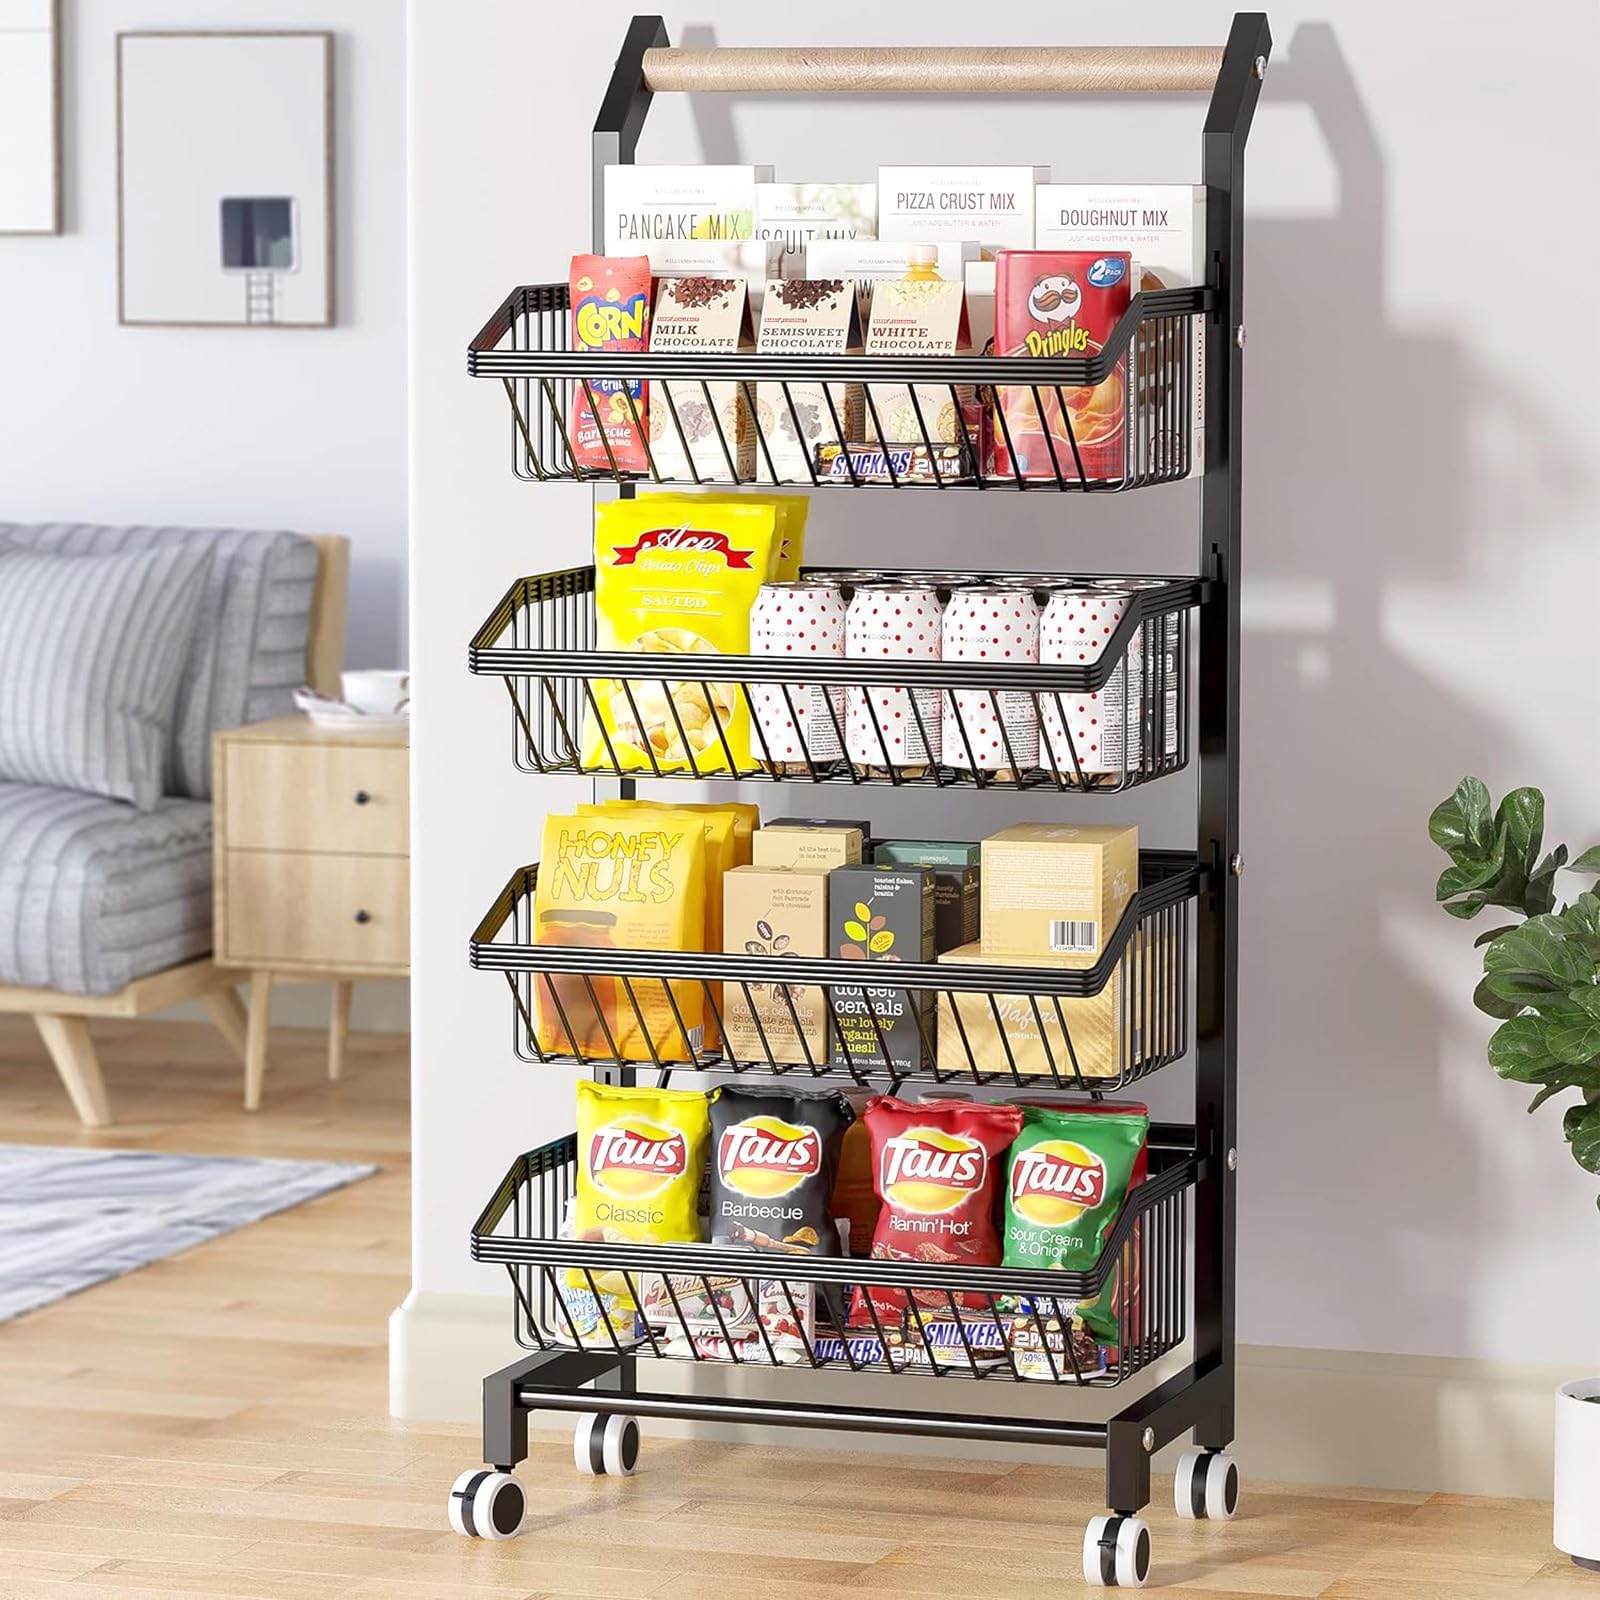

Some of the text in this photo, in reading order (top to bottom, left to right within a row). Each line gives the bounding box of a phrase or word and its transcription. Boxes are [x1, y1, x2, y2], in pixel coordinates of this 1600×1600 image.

[897, 192, 1016, 210] PIZZA CRUST MIX
[618, 213, 741, 240] PANCAKE MIX
[1060, 209, 1169, 227] DOUGHNUT MIX
[1090, 259, 1107, 281] 2
[577, 300, 643, 347] CORN
[655, 325, 698, 335] MILK
[762, 327, 845, 337] SEMISWEET
[872, 327, 929, 338] WHITE
[653, 337, 735, 347] CHOCOLATE
[761, 338, 844, 348] CHOCOLATE
[869, 340, 953, 350] CHOCOLATE
[642, 521, 724, 553] Ace
[642, 594, 708, 609] SALTED
[558, 830, 685, 861] HONEY
[732, 1004, 814, 1017] doet cels
[732, 1015, 815, 1027] chocate graola
[742, 1024, 795, 1035] madamia
[835, 1030, 879, 1042] rganic
[593, 1126, 682, 1171] Taus
[723, 1125, 815, 1171] Taus
[886, 1137, 981, 1185] Taus
[1014, 1151, 1101, 1198] Taus
[595, 1203, 664, 1224] Classic
[721, 1201, 803, 1220] Barbecue
[1009, 1226, 1083, 1248] Sour Cream
[1018, 1241, 1068, 1257] & Onion
[814, 1339, 882, 1361] NICERS
[1030, 1332, 1065, 1350] PCK
